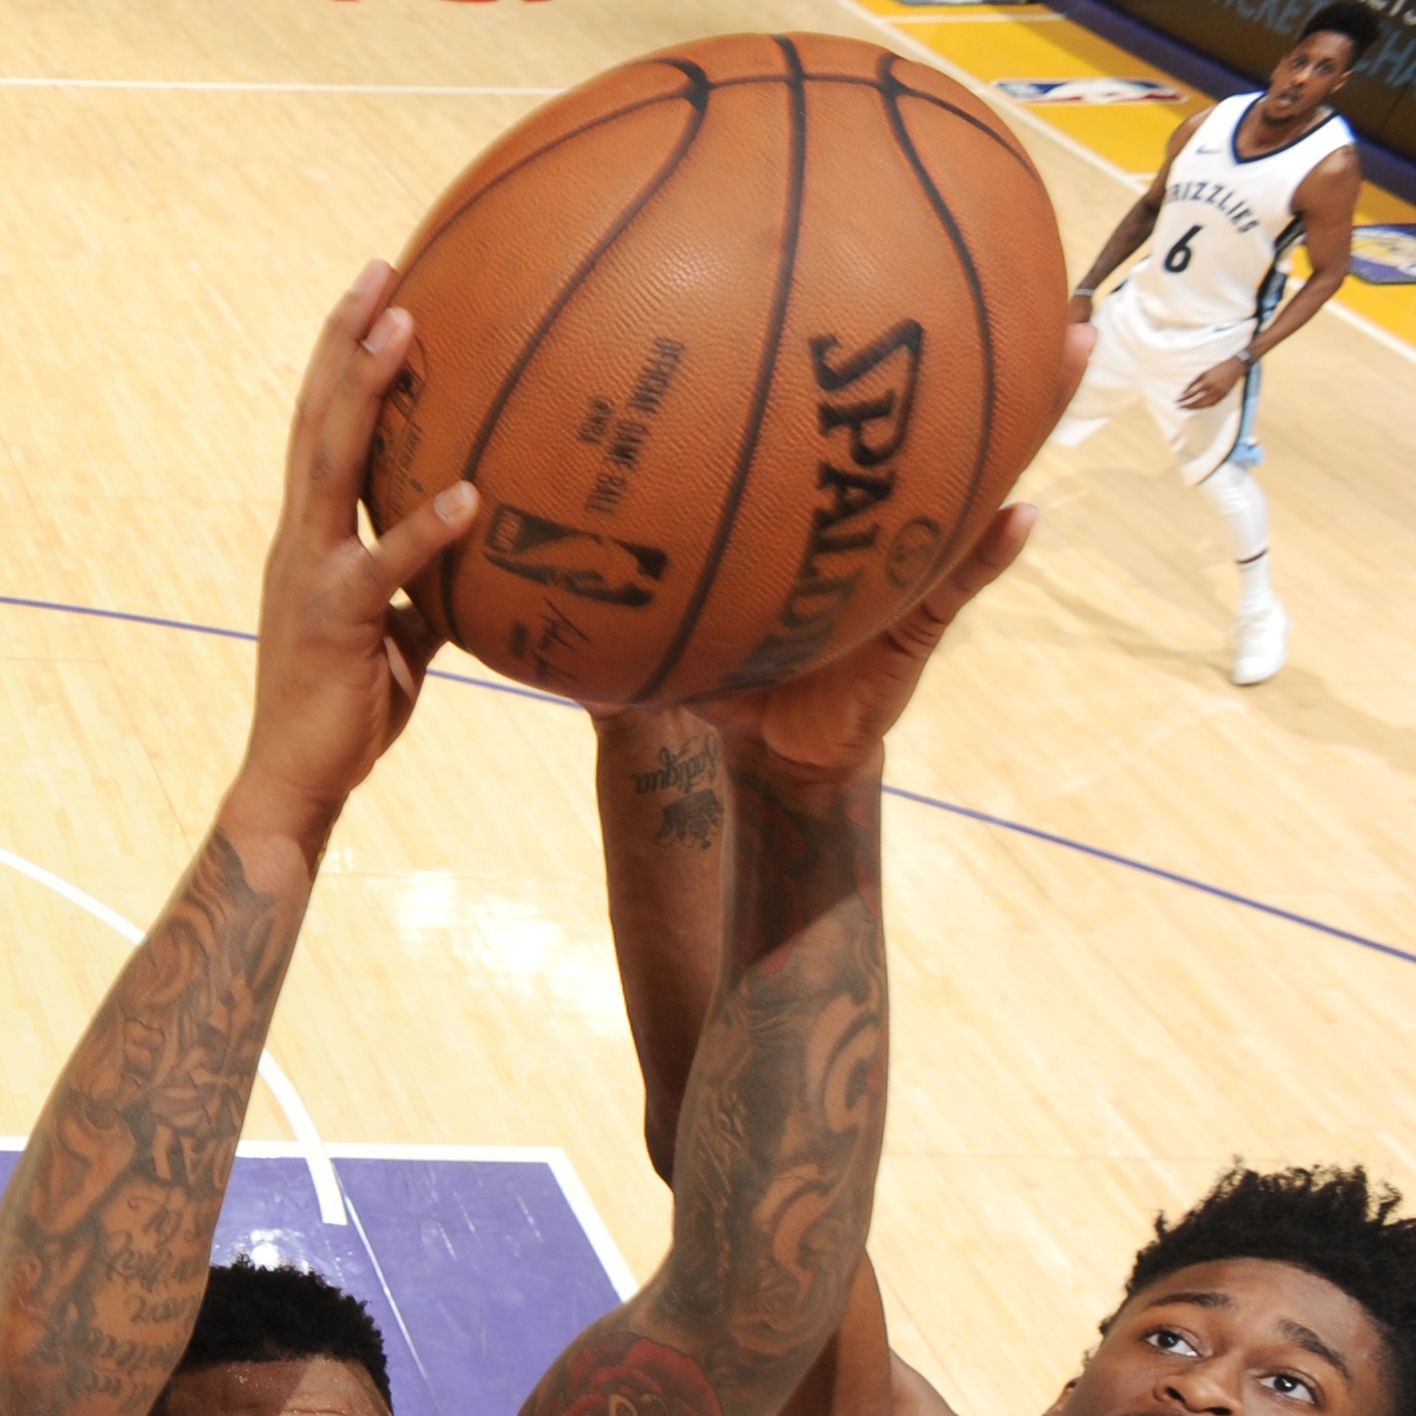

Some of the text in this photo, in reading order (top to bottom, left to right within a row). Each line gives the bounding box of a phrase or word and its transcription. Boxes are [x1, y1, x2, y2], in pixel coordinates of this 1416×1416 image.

[1170, 182, 1259, 234] RIZZLIES
[1164, 225, 1204, 273] 6
[605, 419, 650, 472] GAME
[584, 472, 626, 518] BALL
